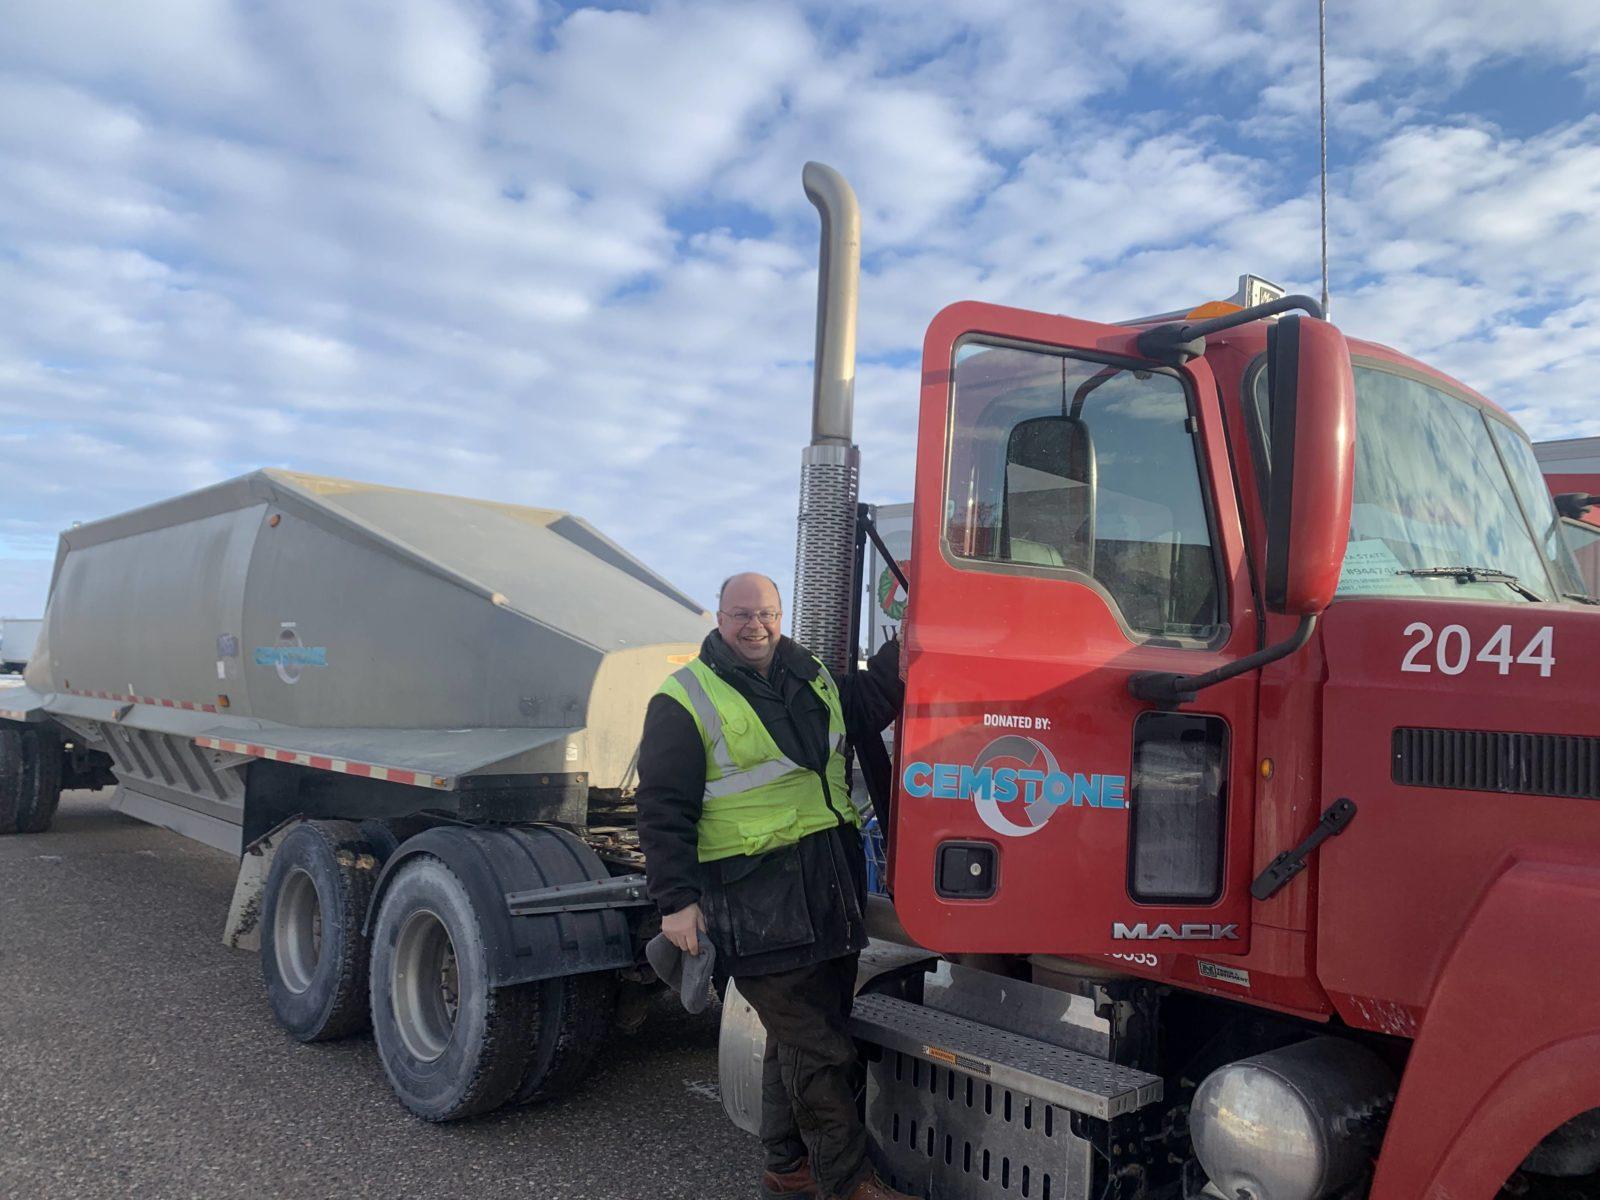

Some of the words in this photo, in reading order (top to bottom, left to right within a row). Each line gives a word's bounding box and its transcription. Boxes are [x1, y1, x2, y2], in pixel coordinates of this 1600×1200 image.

[1401, 622, 1555, 677] 2044
[983, 713, 1032, 729] DONATED
[1035, 717, 1051, 730] BY:
[903, 762, 1126, 809] CEMSTONE
[1113, 922, 1240, 940] MACK
